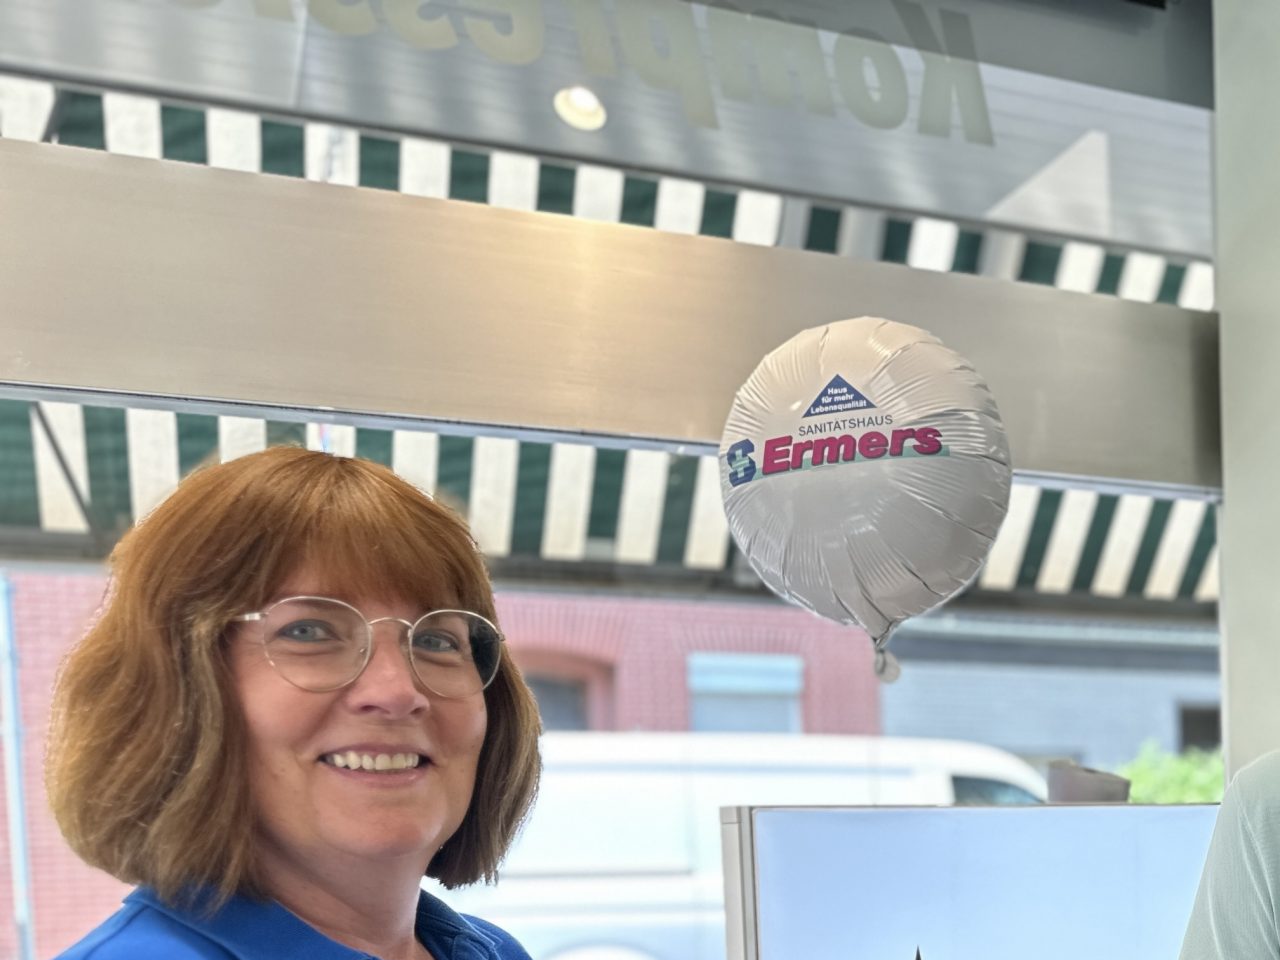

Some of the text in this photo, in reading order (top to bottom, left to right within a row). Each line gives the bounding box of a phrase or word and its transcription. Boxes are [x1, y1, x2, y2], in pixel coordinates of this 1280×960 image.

[827, 387, 848, 395] Haus
[821, 393, 855, 404] für mehr
[810, 400, 867, 414] Lebensqualität
[798, 414, 893, 436] SANITÄTSHAUS
[762, 427, 943, 475] Ermers
